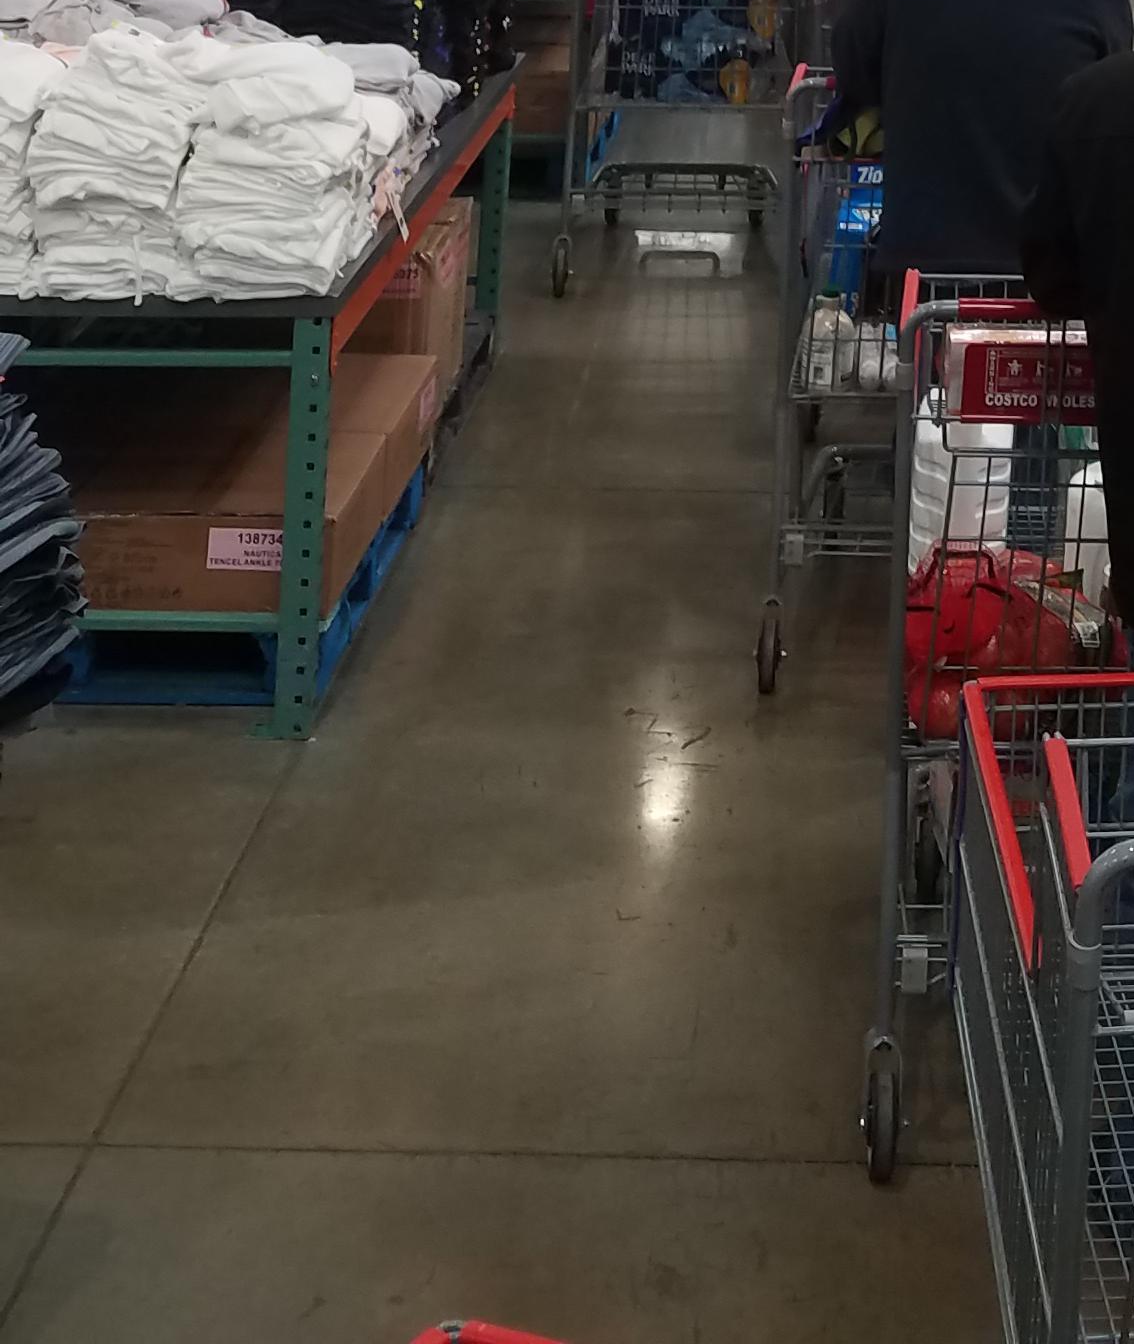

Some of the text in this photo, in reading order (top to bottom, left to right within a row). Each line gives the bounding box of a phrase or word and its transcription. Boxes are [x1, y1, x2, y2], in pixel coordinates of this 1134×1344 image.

[985, 394, 1096, 408] COSTCO WHOLES
[209, 558, 240, 566] TENCEL
[245, 558, 271, 566] ANKLE
